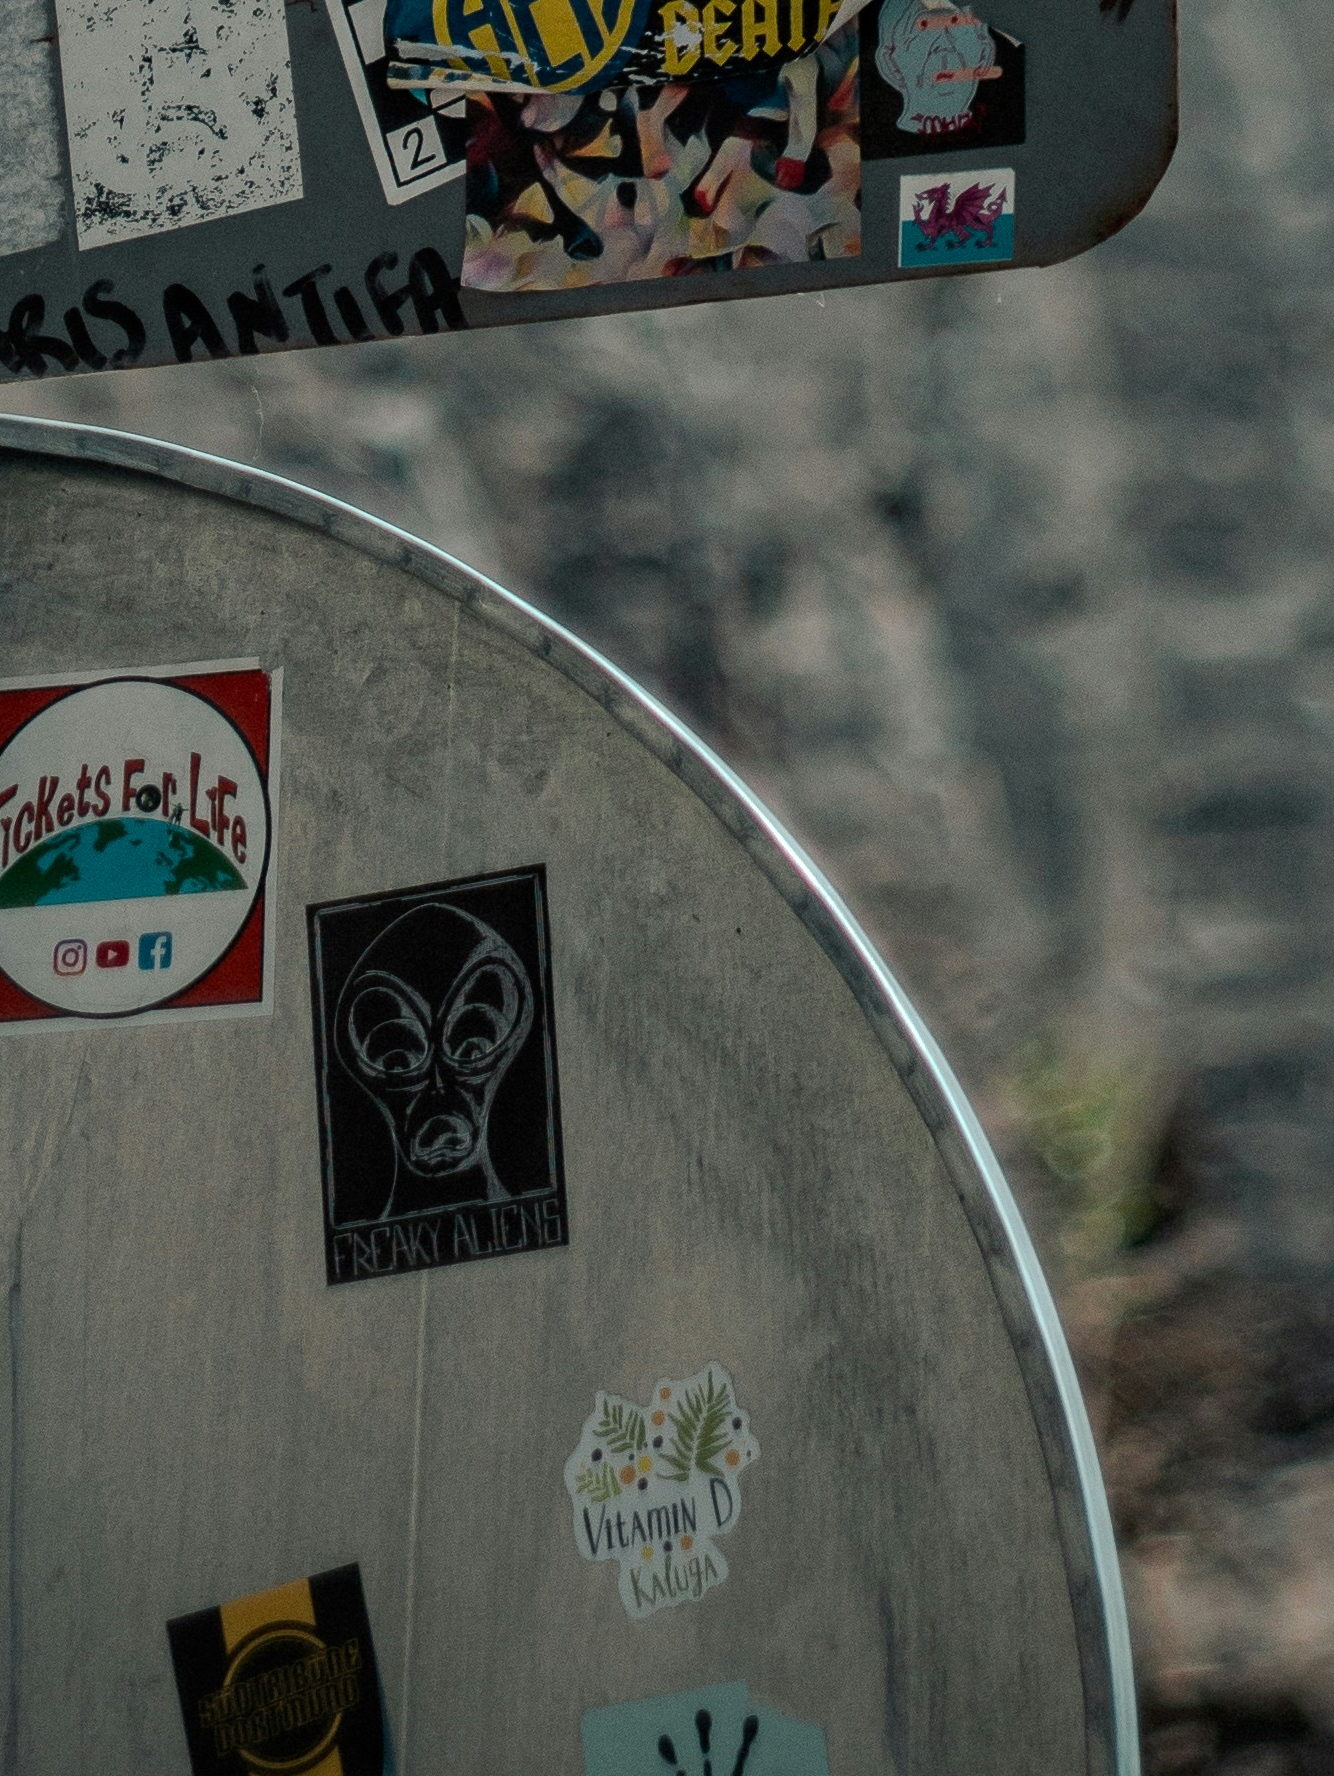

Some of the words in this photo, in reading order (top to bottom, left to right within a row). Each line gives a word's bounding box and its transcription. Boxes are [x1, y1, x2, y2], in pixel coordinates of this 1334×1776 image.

[163, 247, 468, 363] ANTIFA
[334, 1218, 441, 1278] FREAKY
[454, 1198, 562, 1259] ALIENS
[710, 1477, 734, 1529] D
